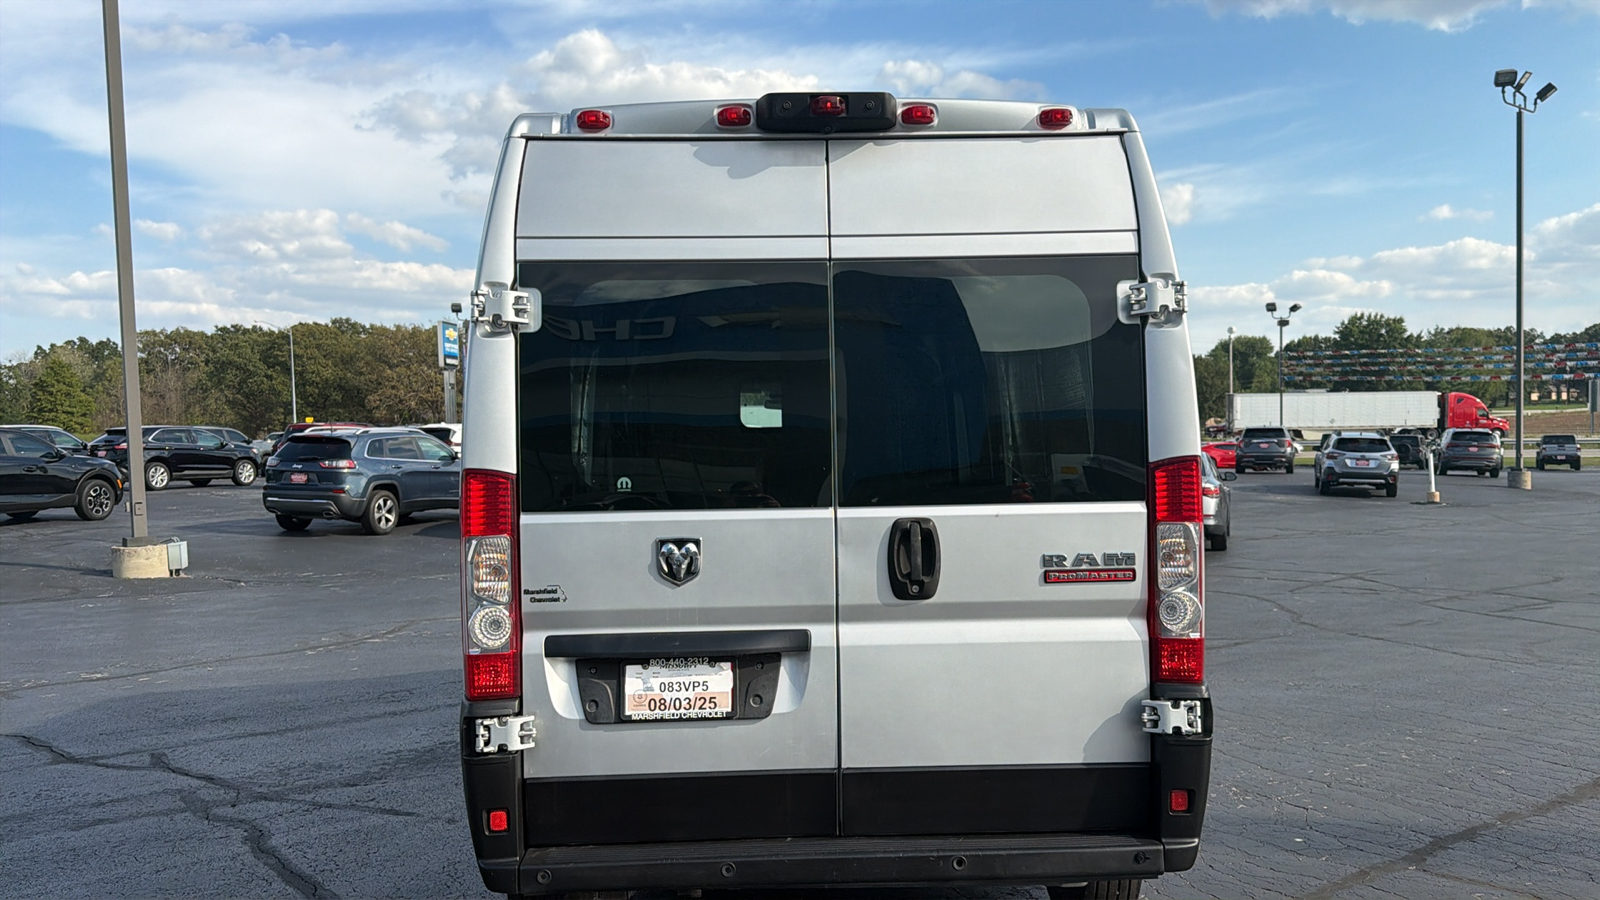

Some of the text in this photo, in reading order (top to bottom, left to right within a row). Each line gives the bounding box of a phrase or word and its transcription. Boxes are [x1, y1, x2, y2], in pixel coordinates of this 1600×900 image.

[1043, 552, 1136, 567] RAM
[649, 657, 709, 667] 800-440-2312
[659, 681, 709, 692] 083VP5
[648, 697, 717, 711] 08/03/25
[681, 711, 727, 719] CHEVROLET
